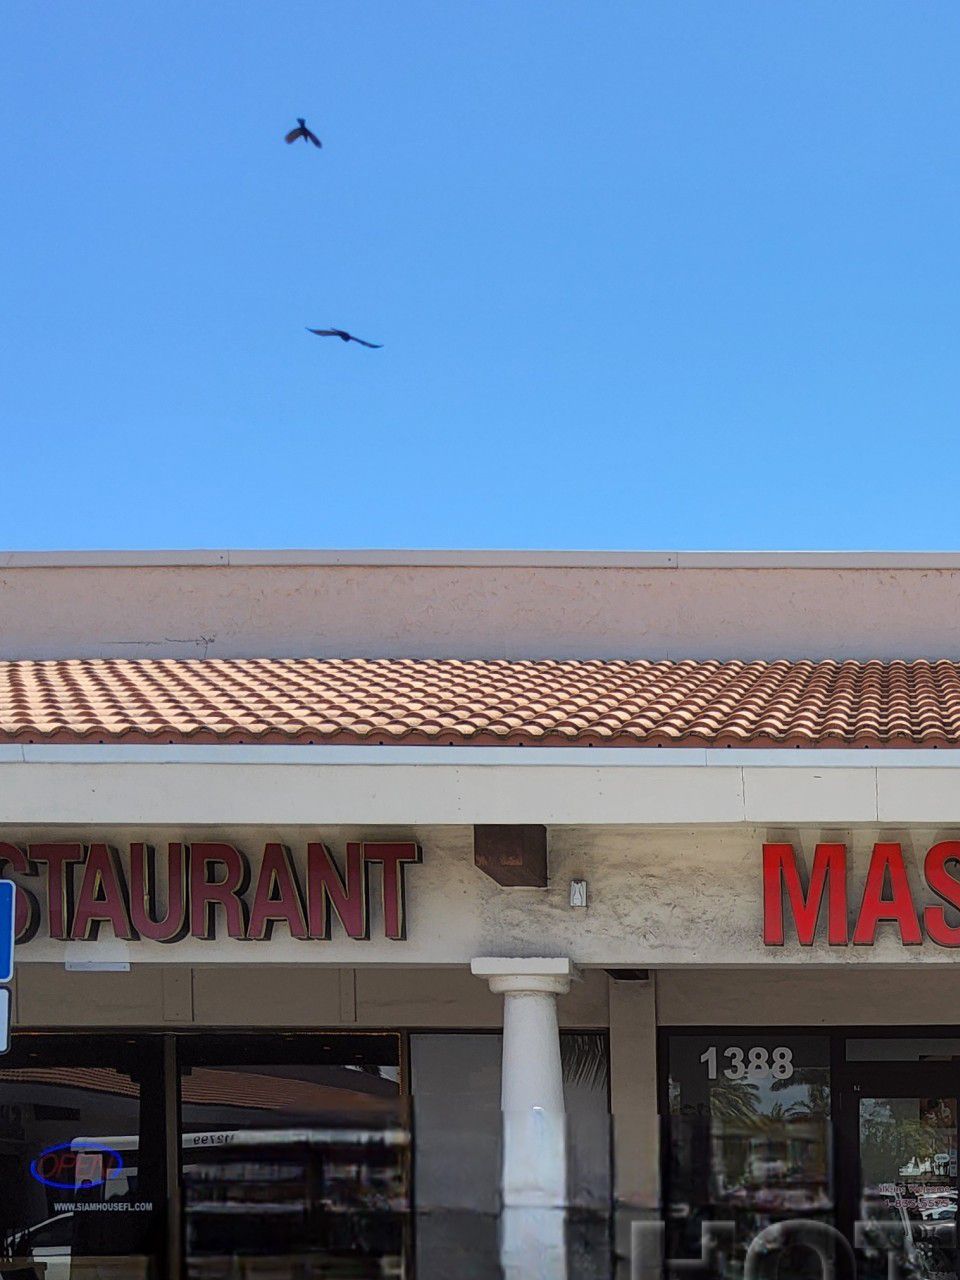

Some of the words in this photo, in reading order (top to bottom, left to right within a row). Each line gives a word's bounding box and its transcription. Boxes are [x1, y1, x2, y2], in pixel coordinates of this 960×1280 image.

[700, 1046, 794, 1080] 1388
[37, 1153, 115, 1179] OPEN
[54, 1202, 153, 1212] WWW.SIAMHOUSEFL.COM
